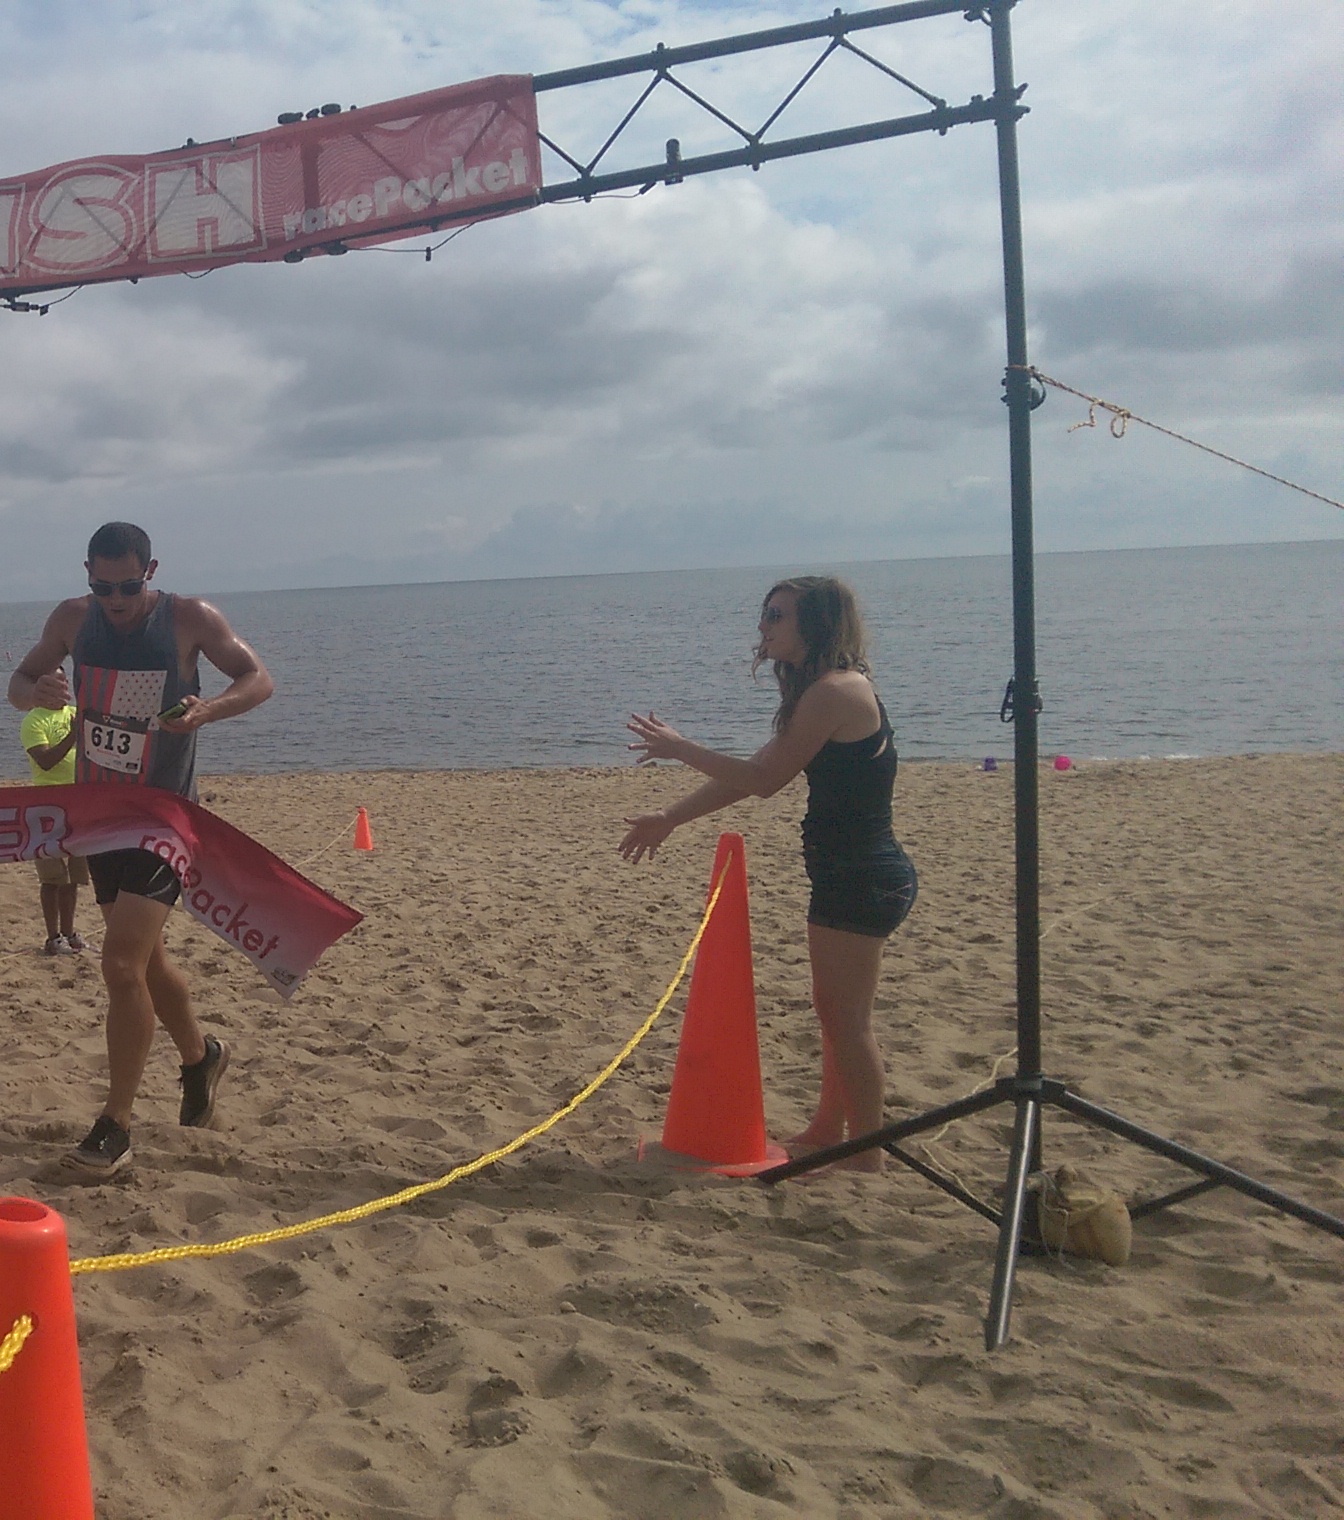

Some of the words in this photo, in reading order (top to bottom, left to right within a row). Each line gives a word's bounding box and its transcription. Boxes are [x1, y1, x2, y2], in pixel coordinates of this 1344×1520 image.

[283, 148, 528, 241] racePacket
[91, 726, 131, 755] 613
[139, 834, 280, 960] raceacket
